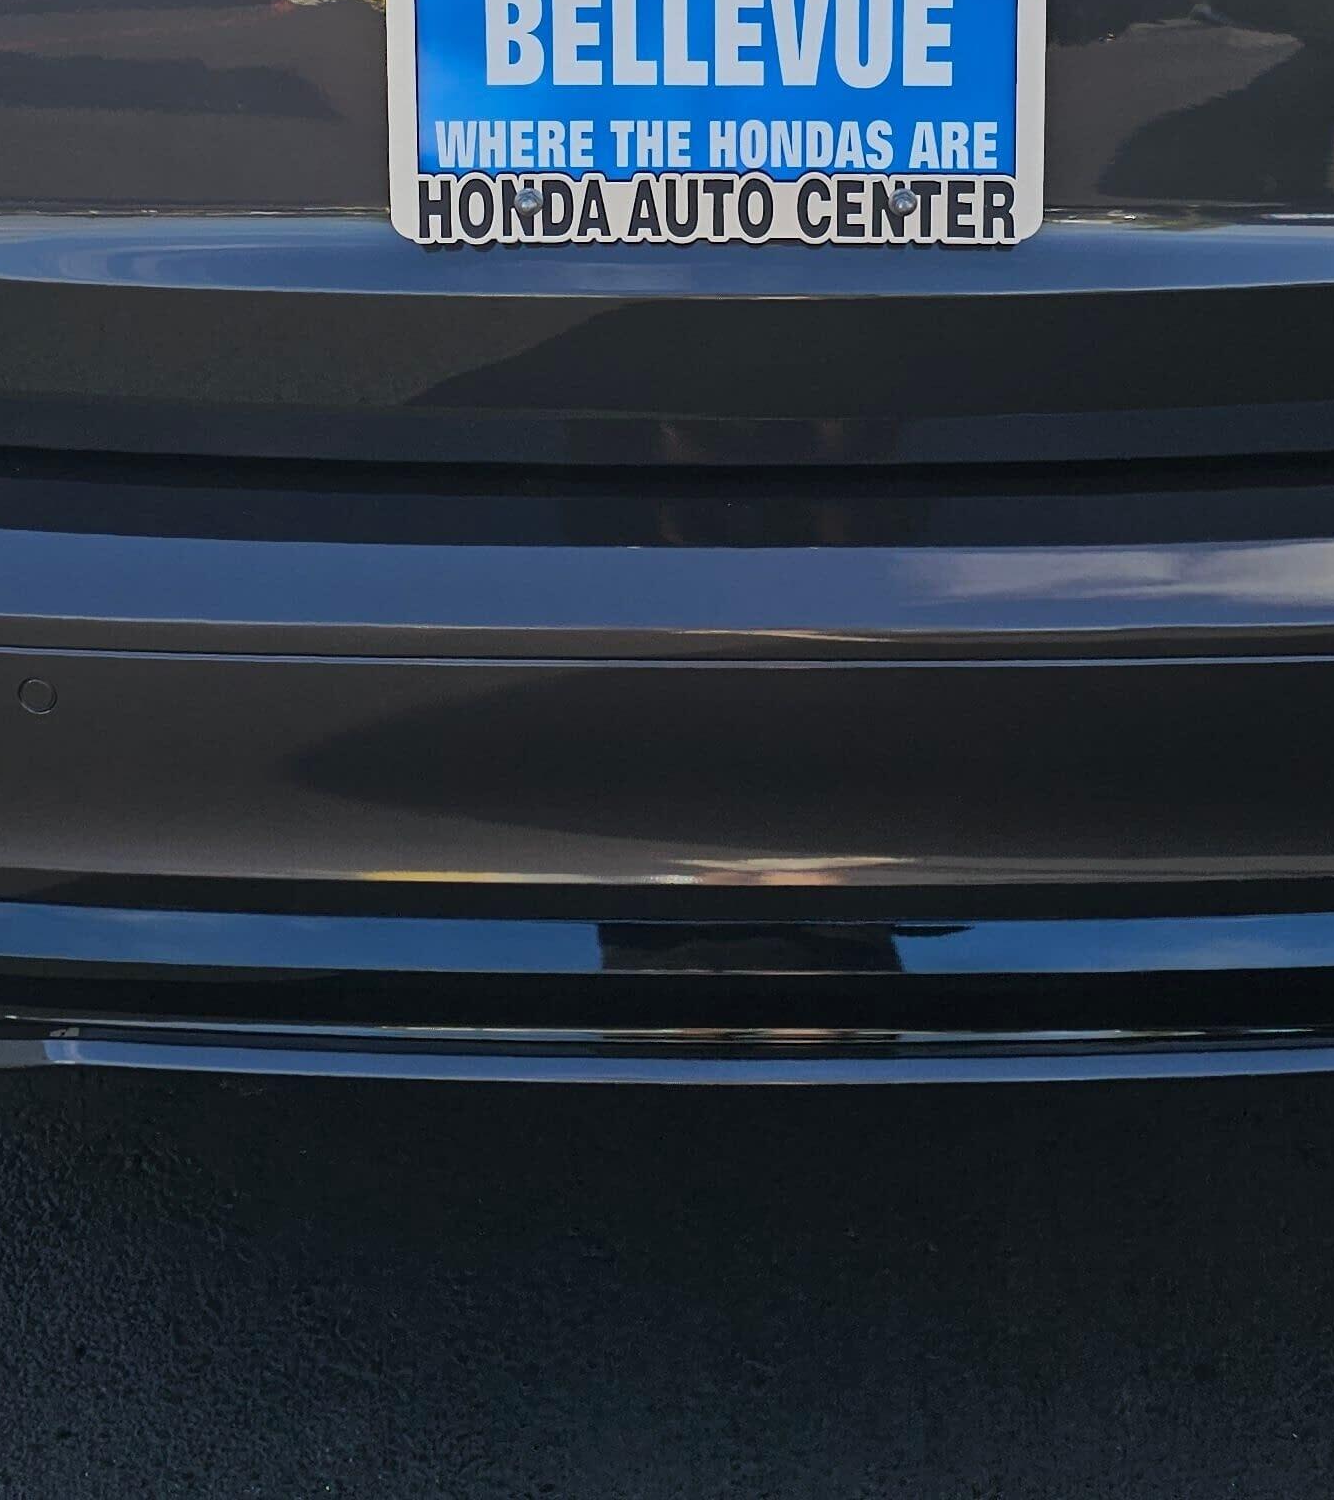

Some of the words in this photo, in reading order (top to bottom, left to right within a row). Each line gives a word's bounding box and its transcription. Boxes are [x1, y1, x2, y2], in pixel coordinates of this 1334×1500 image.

[435, 120, 593, 169] WHERE
[610, 121, 690, 169] THE
[709, 120, 894, 171] HONDAS
[909, 121, 998, 169] ARE
[418, 178, 611, 238] HONDA
[628, 178, 773, 238] AUTO
[797, 178, 1015, 238] CENTER
